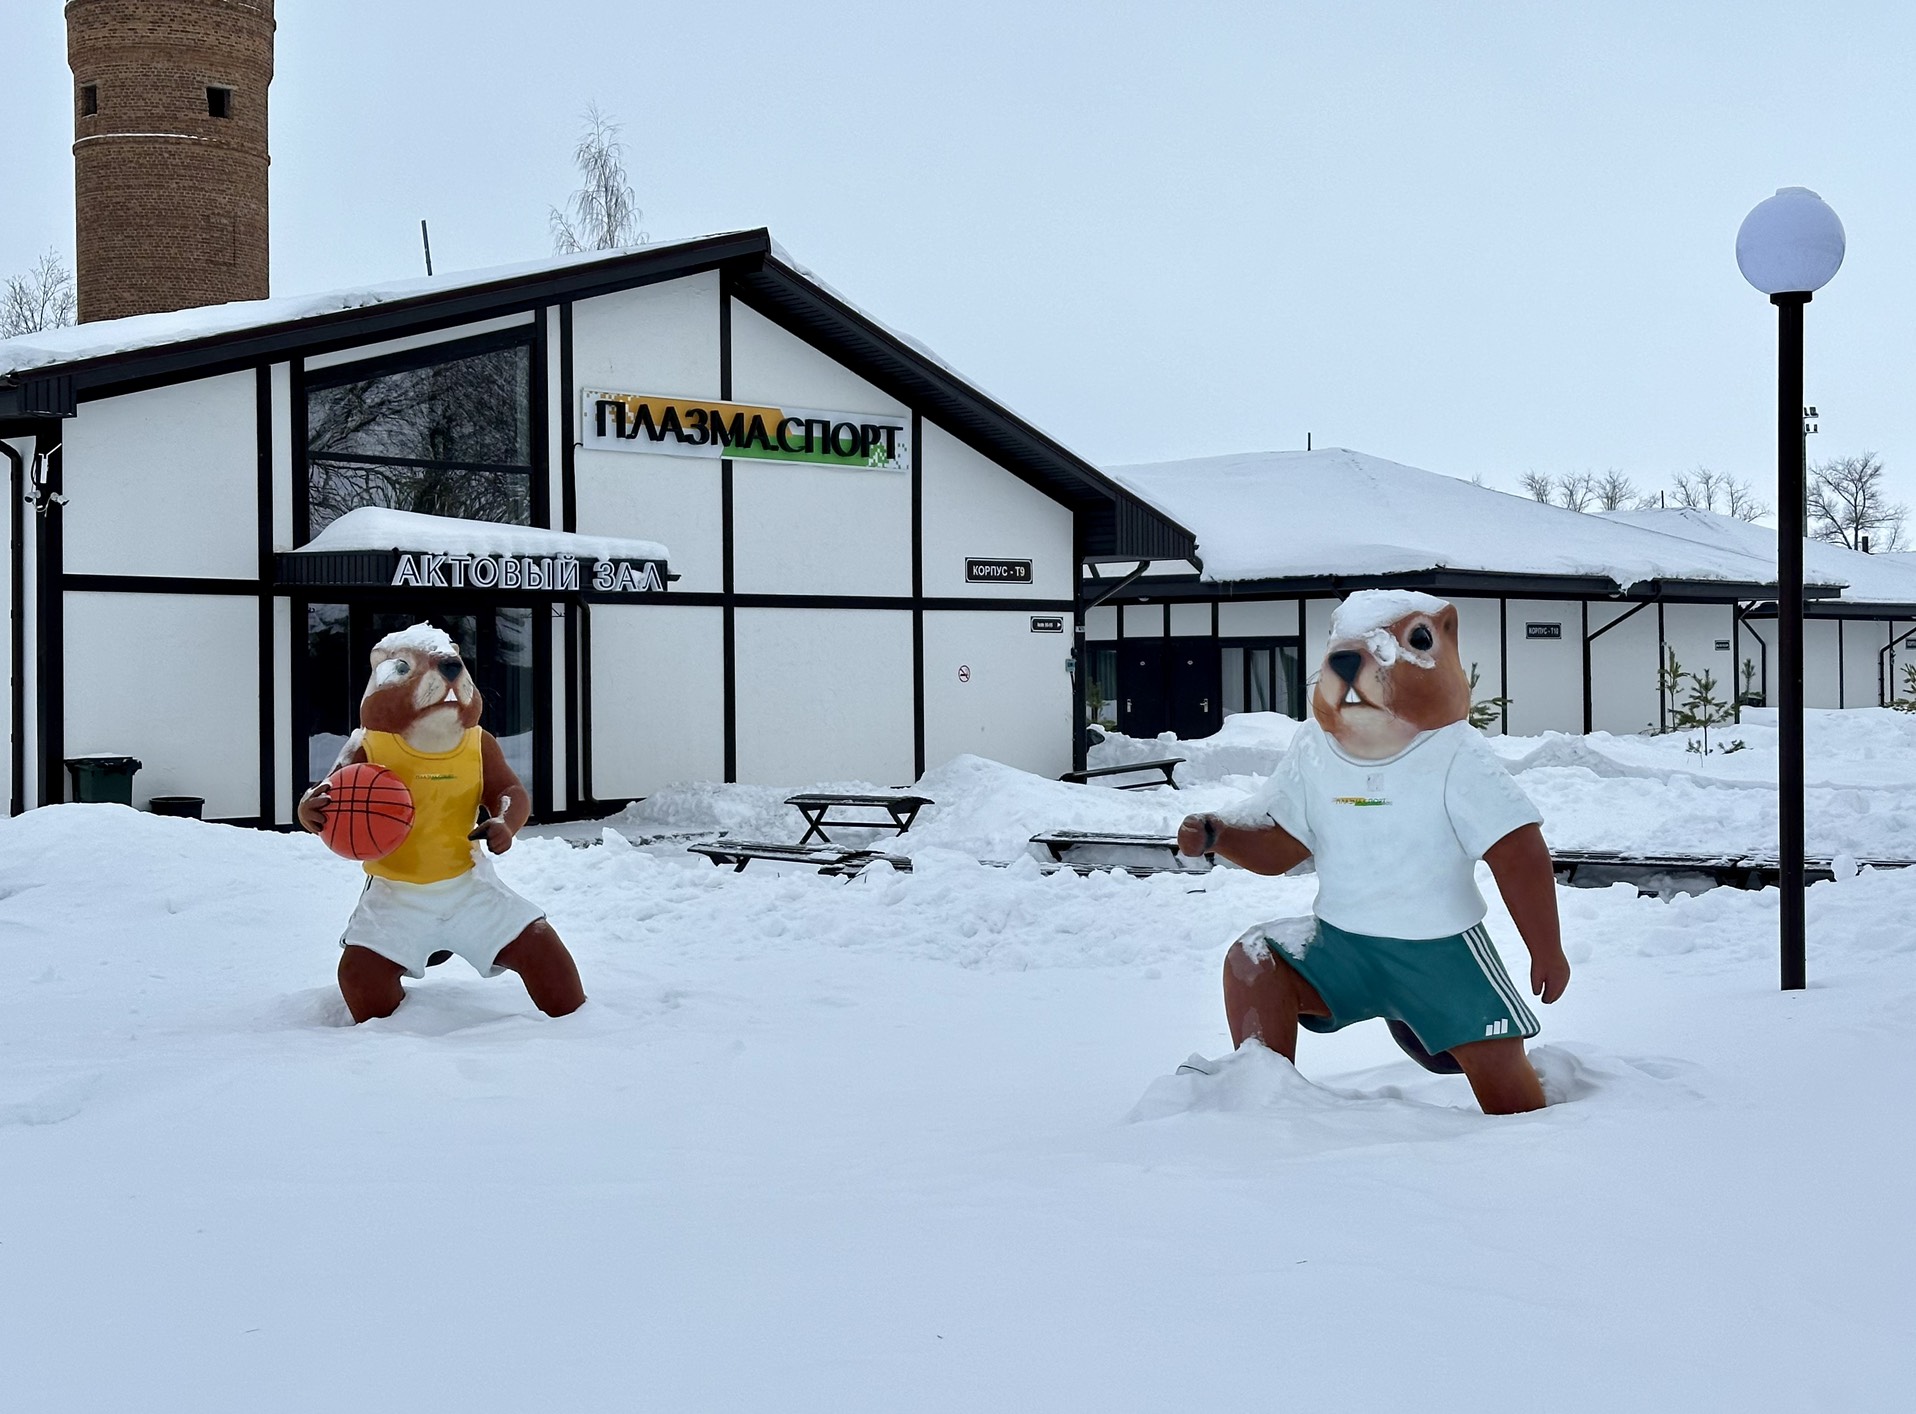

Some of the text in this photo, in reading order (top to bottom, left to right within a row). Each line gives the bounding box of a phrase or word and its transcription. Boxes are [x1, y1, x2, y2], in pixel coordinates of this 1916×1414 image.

[391, 553, 664, 591] АКТОВЫЙ ЗАЛ
[972, 565, 1008, 577] КОРПУС
